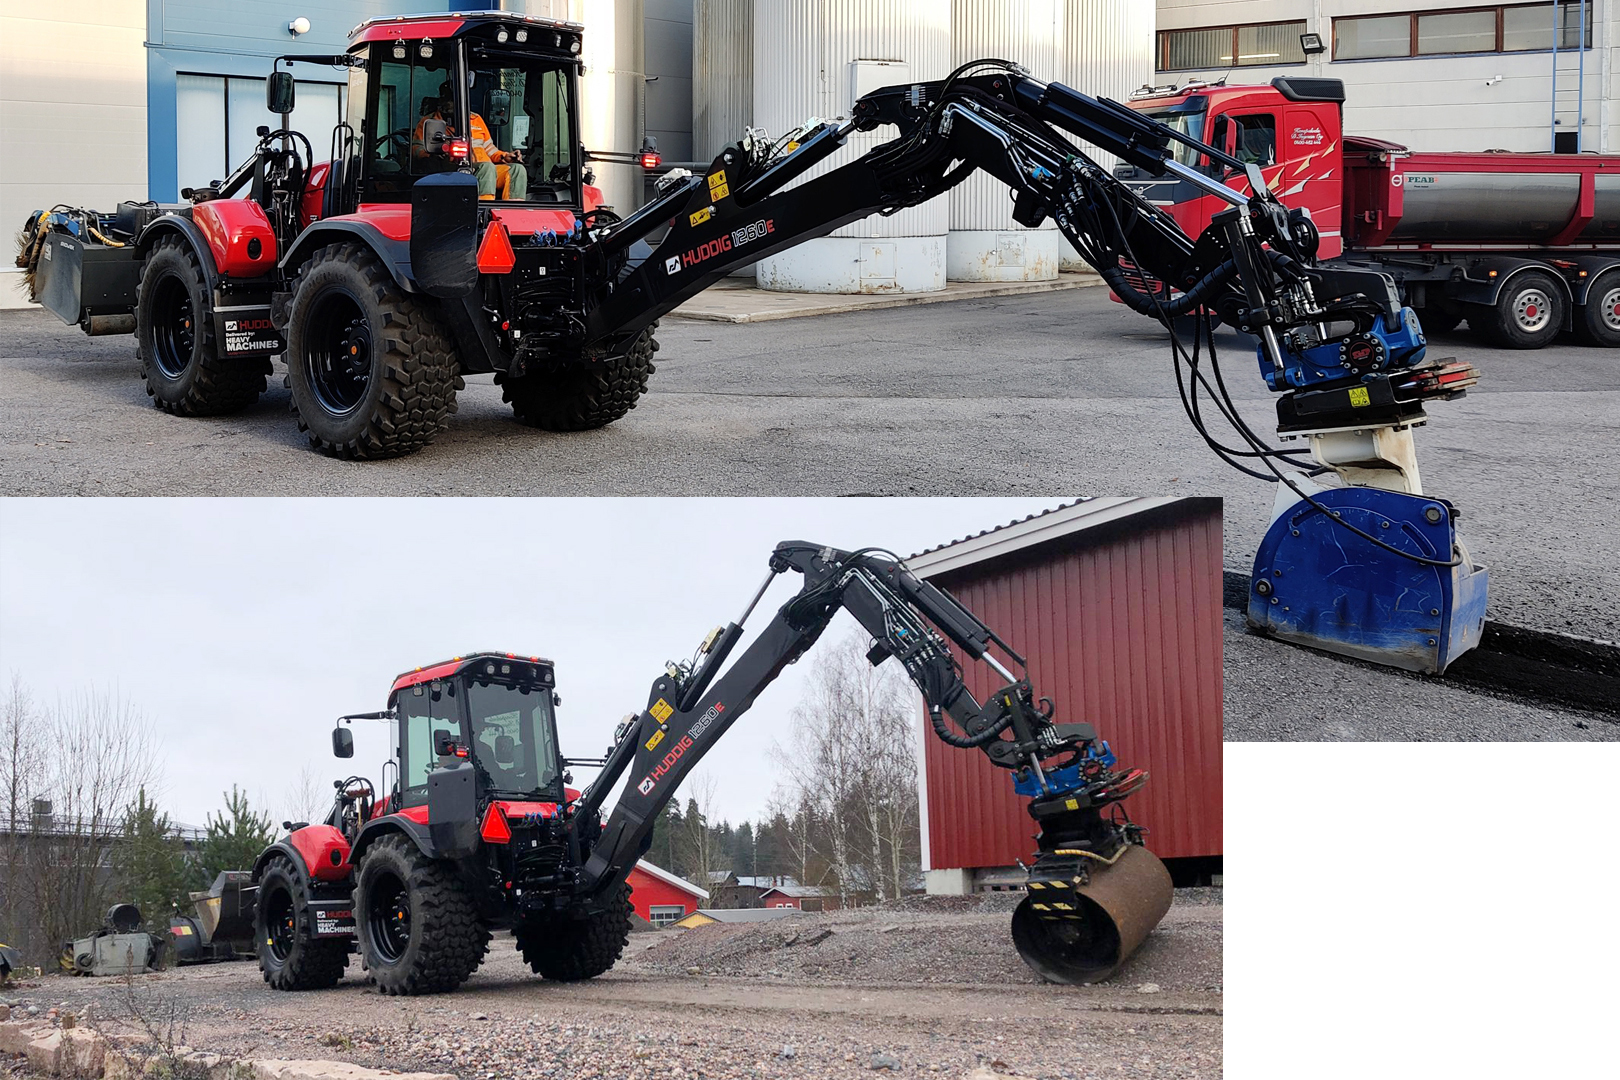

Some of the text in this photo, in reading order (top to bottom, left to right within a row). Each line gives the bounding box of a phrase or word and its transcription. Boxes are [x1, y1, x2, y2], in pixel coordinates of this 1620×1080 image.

[1407, 176, 1435, 184] PEAB
[682, 235, 732, 268] HUDDIG
[225, 336, 250, 345] HEAVY
[226, 340, 279, 352] MACHINES
[651, 735, 693, 781] HUDDIG
